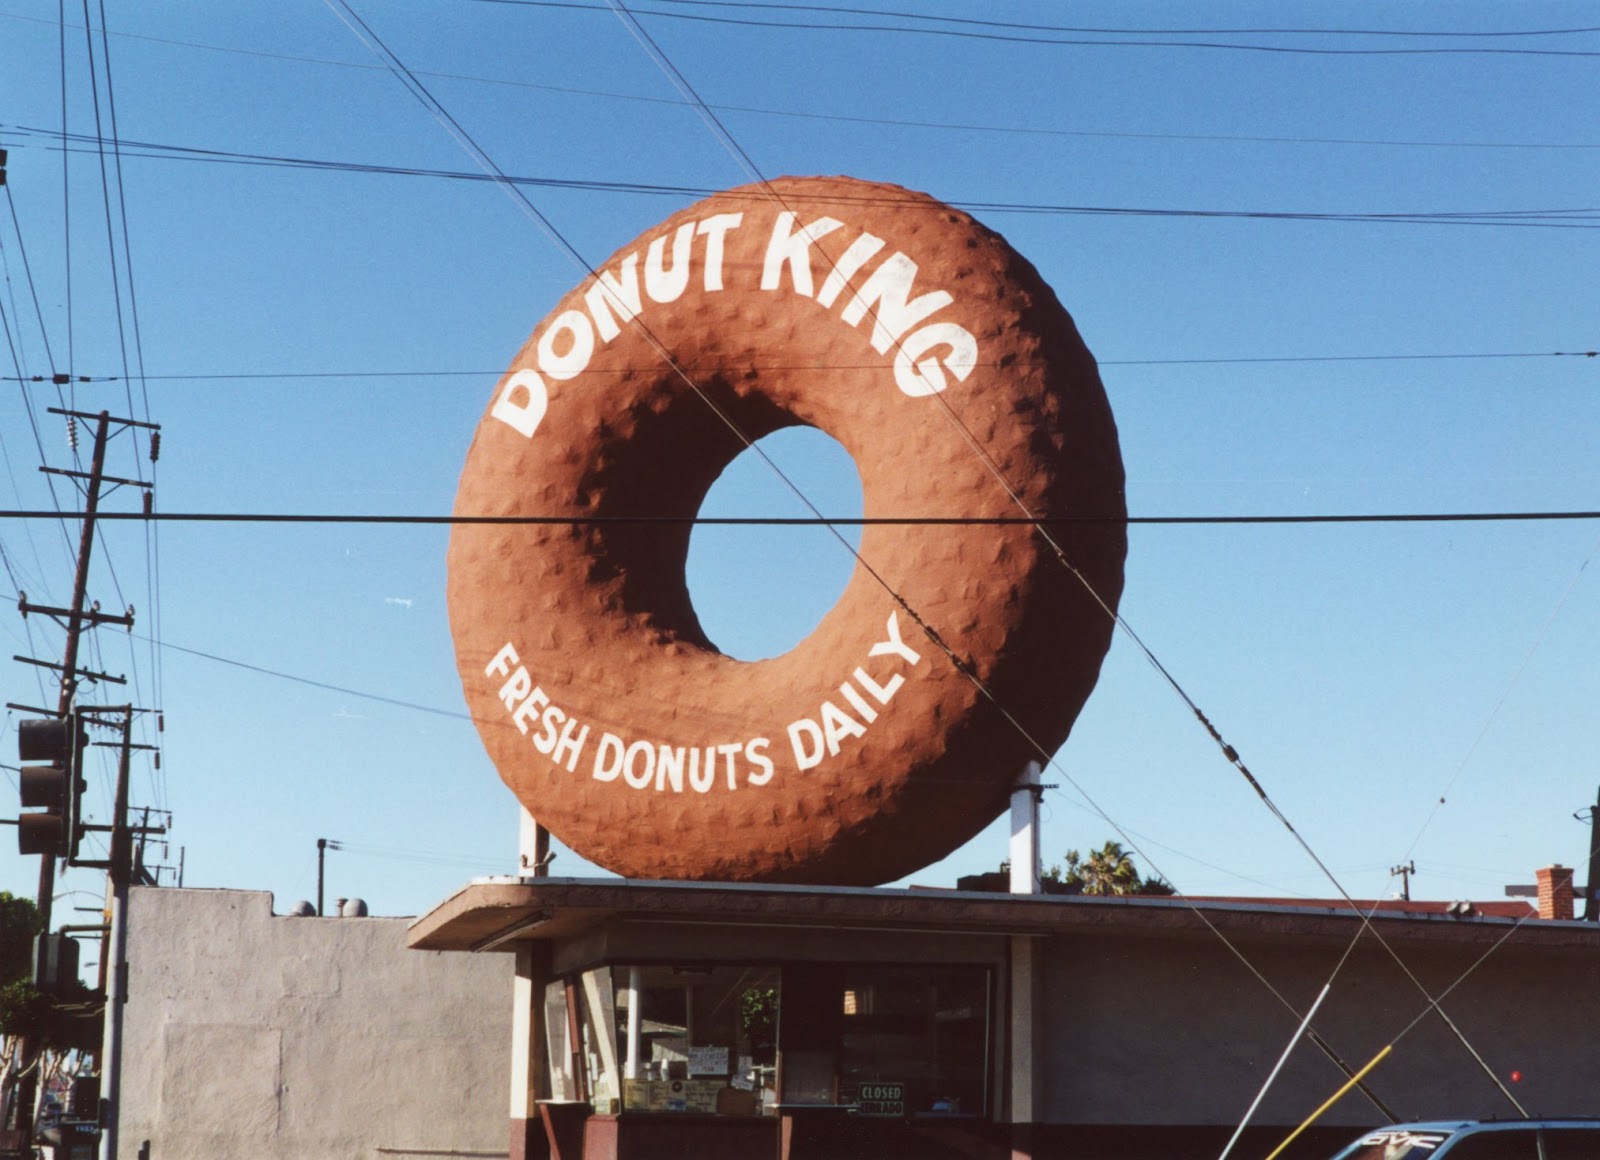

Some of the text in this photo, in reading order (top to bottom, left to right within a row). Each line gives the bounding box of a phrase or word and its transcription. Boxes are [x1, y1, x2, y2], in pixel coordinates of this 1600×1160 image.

[491, 211, 978, 438] DONUT KING
[485, 610, 921, 793] FRESH DONUTS DAILY
[862, 1086, 901, 1099] CLOSED
